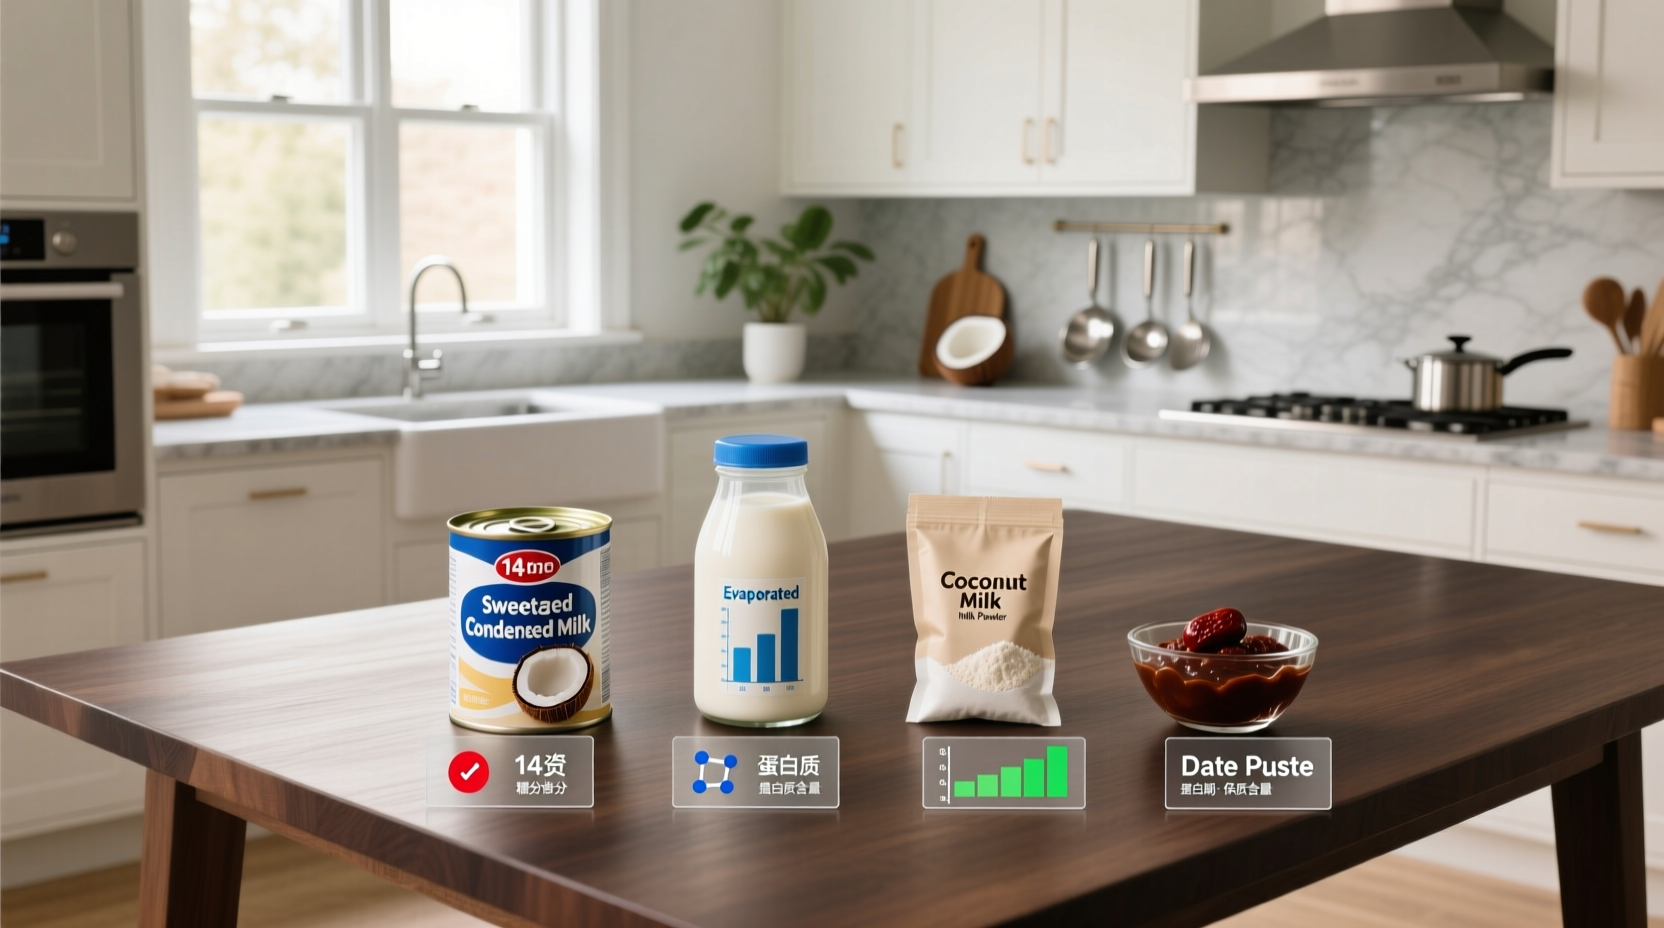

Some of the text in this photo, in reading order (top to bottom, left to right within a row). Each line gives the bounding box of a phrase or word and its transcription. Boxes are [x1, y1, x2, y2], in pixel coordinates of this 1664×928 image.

[940, 571, 1027, 591] Coconut
[723, 584, 799, 604] Evaporated
[960, 592, 1001, 609] Milk
[558, 613, 591, 636] Milk
[758, 754, 820, 776] 蛋白质
[1182, 755, 1314, 777] Date Puste
